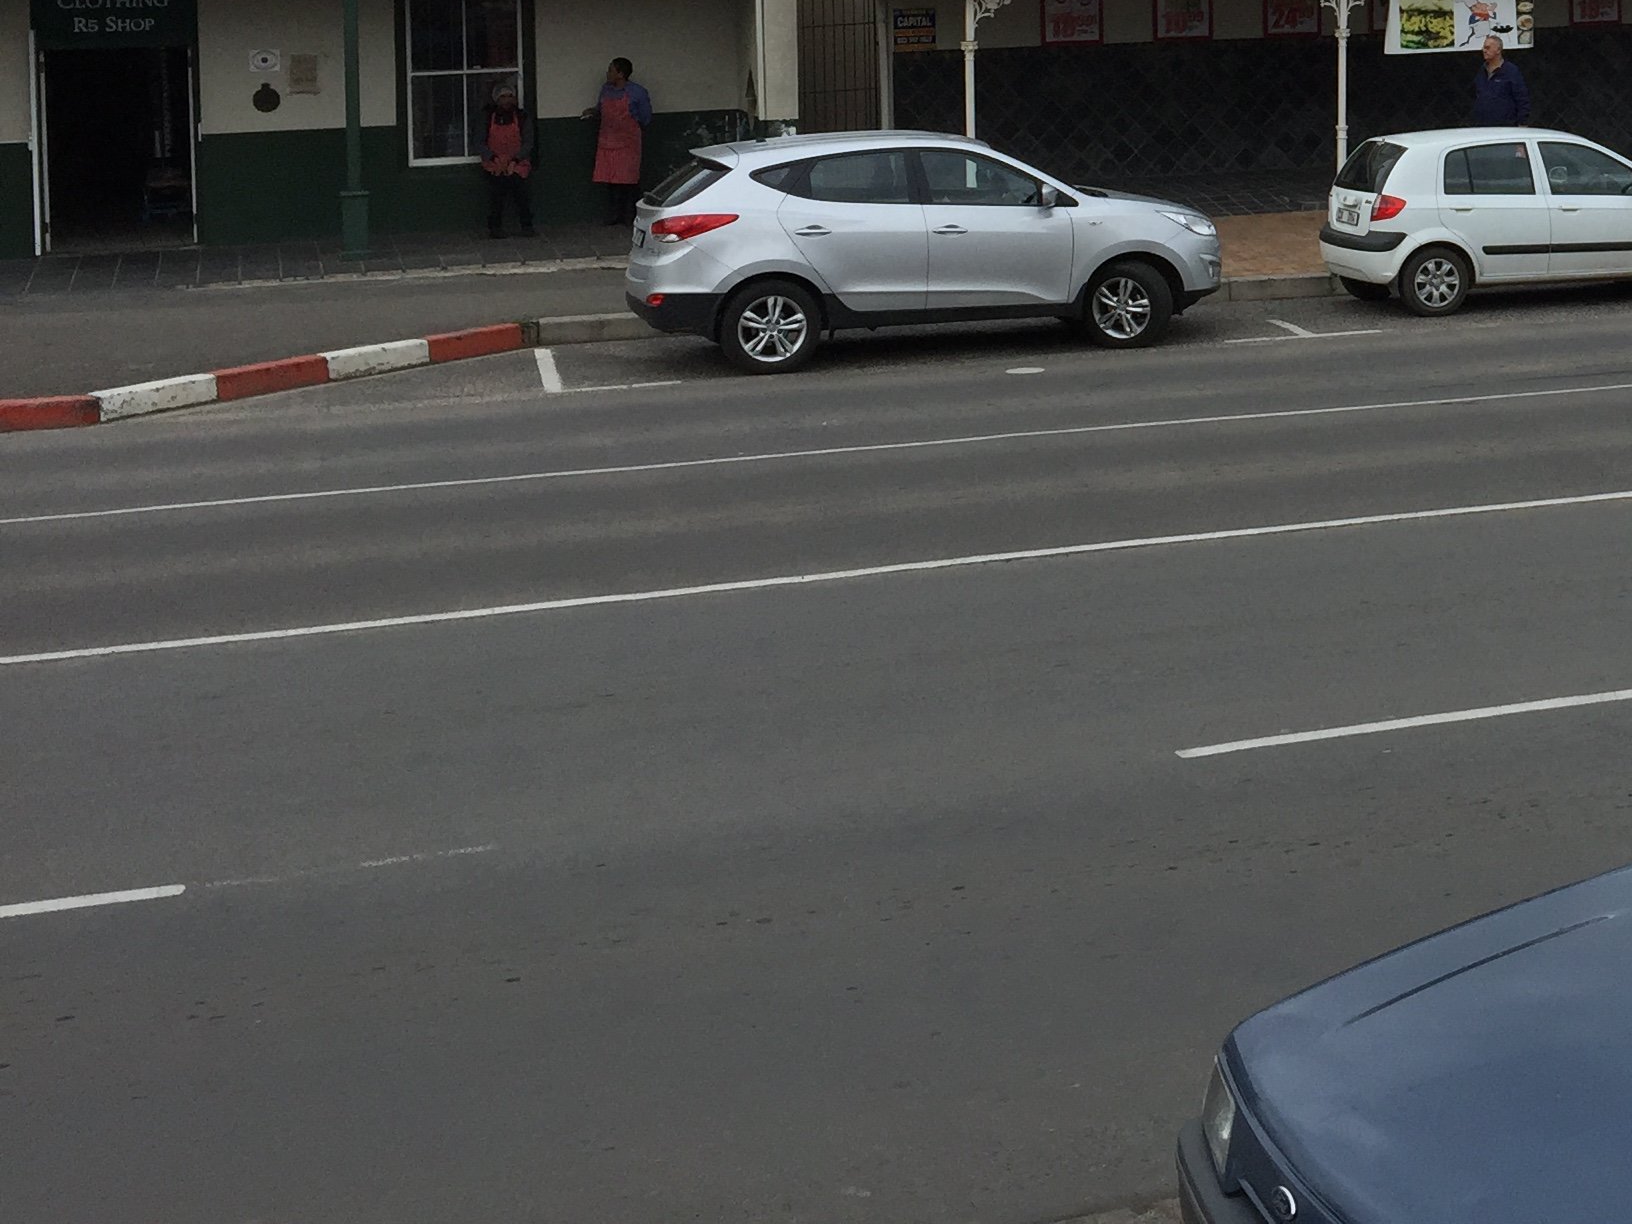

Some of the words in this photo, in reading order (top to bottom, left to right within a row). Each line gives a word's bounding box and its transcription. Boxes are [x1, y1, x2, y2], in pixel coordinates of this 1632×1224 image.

[73, 17, 98, 33] R5
[105, 16, 155, 32] SHOP
[896, 16, 932, 27] CAPITAL
